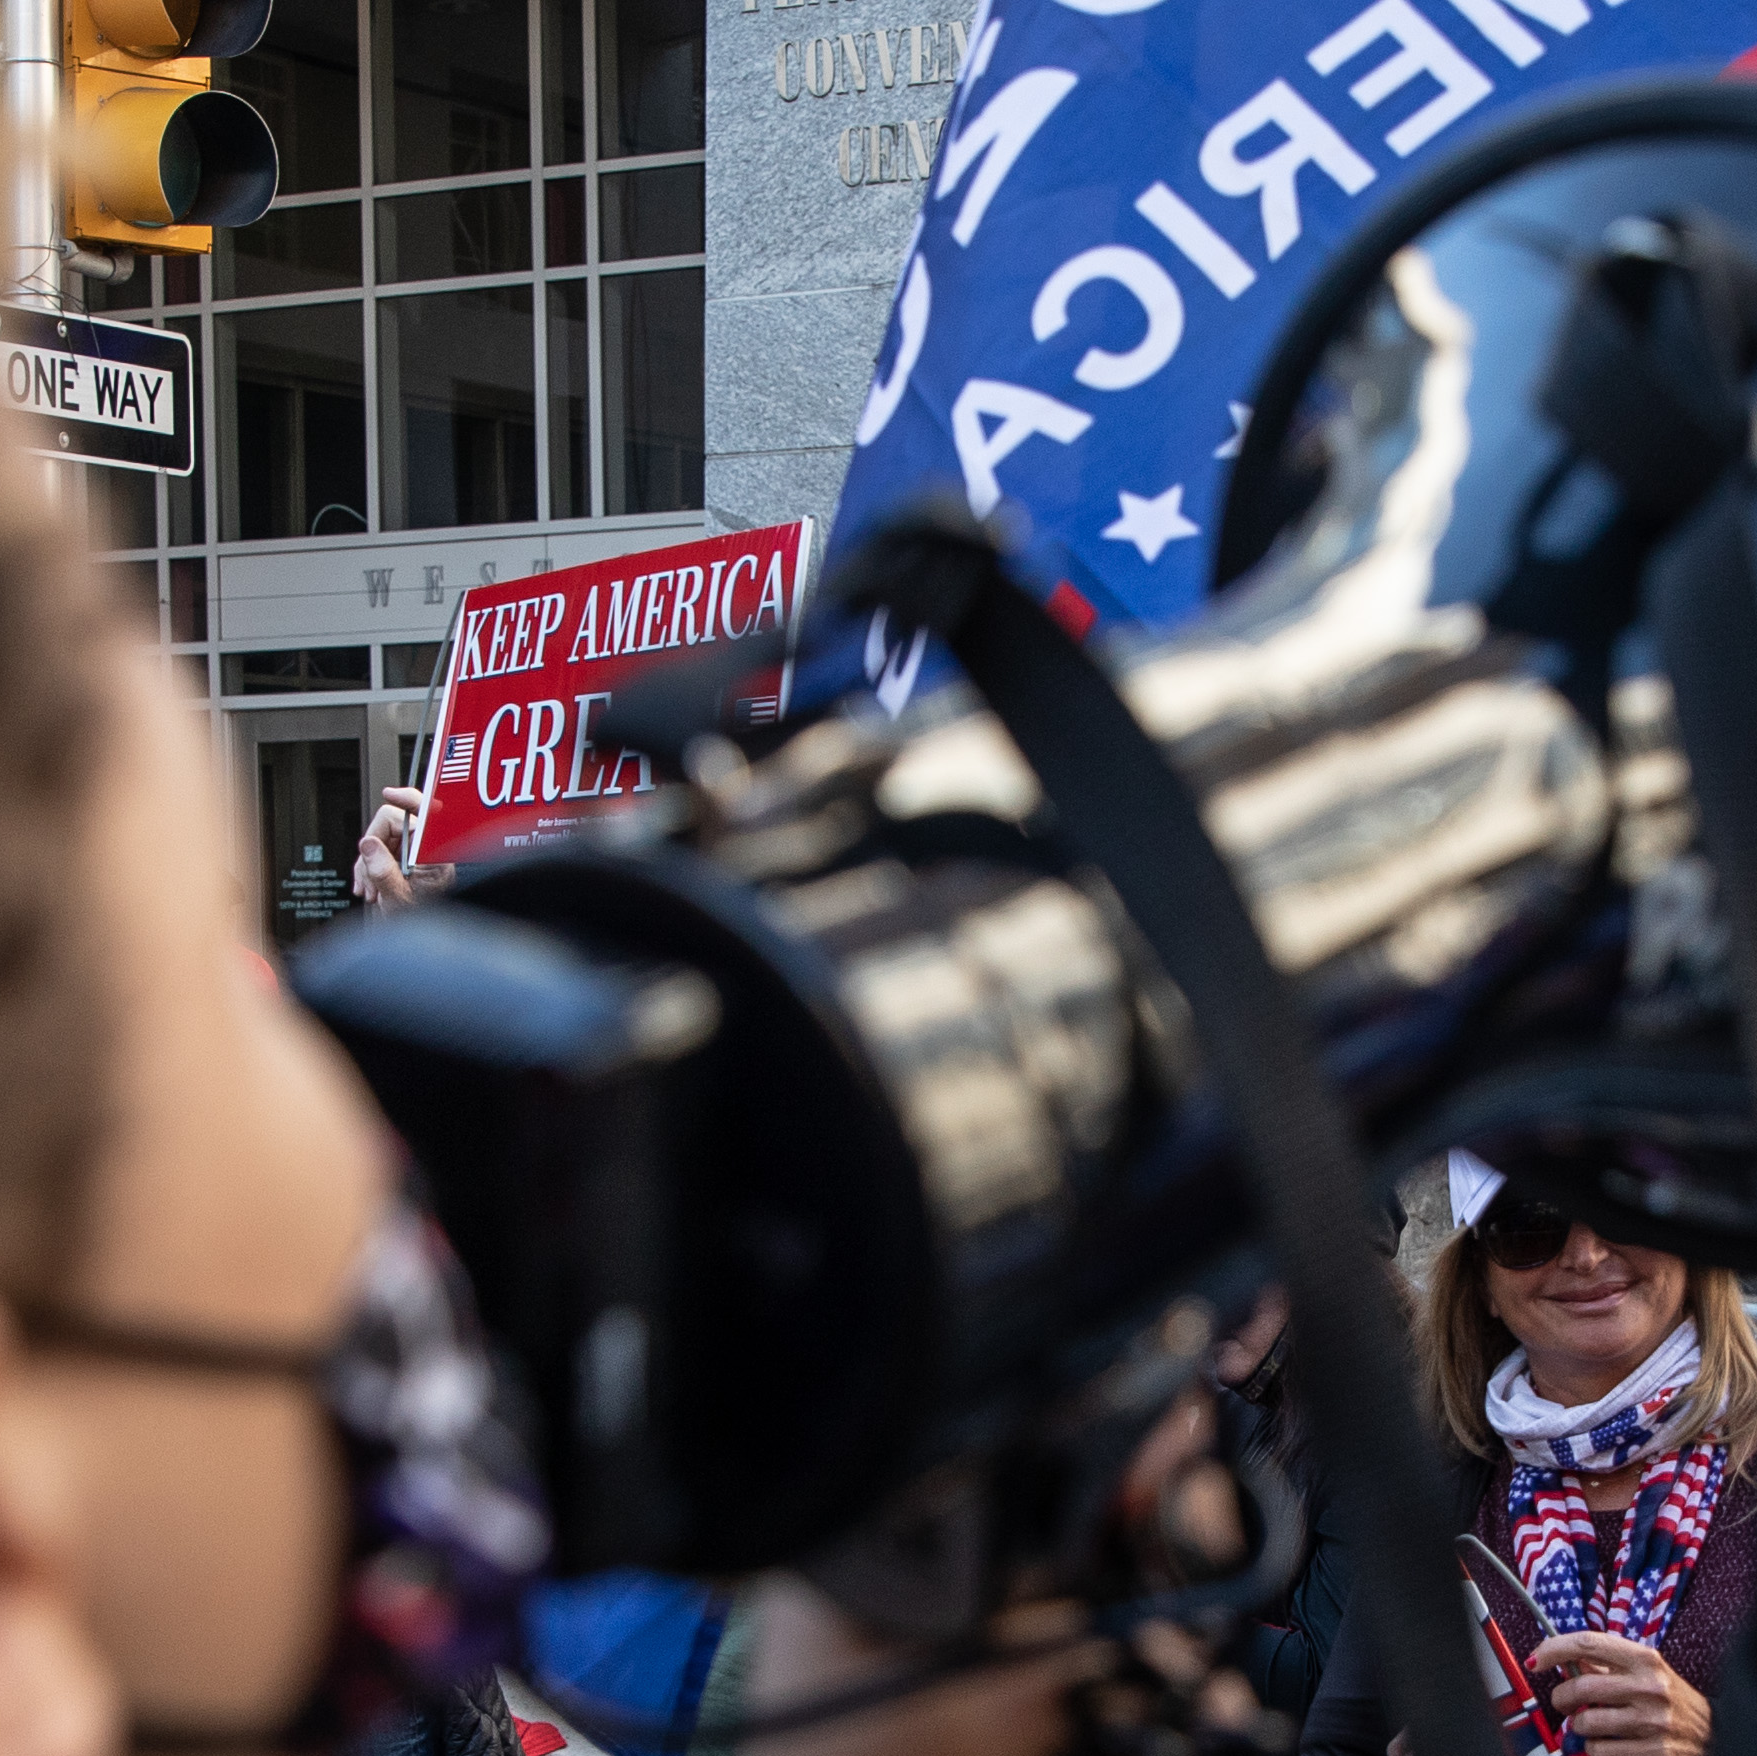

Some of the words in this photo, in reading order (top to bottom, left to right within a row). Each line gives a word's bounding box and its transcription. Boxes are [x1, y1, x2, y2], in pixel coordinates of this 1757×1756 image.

[839, 117, 946, 187] CEN
[8, 351, 80, 412] ONE
[94, 364, 164, 424] WAY
[457, 593, 565, 683] KEEP
[567, 551, 785, 663] AMERICA
[476, 691, 657, 808] GREA
